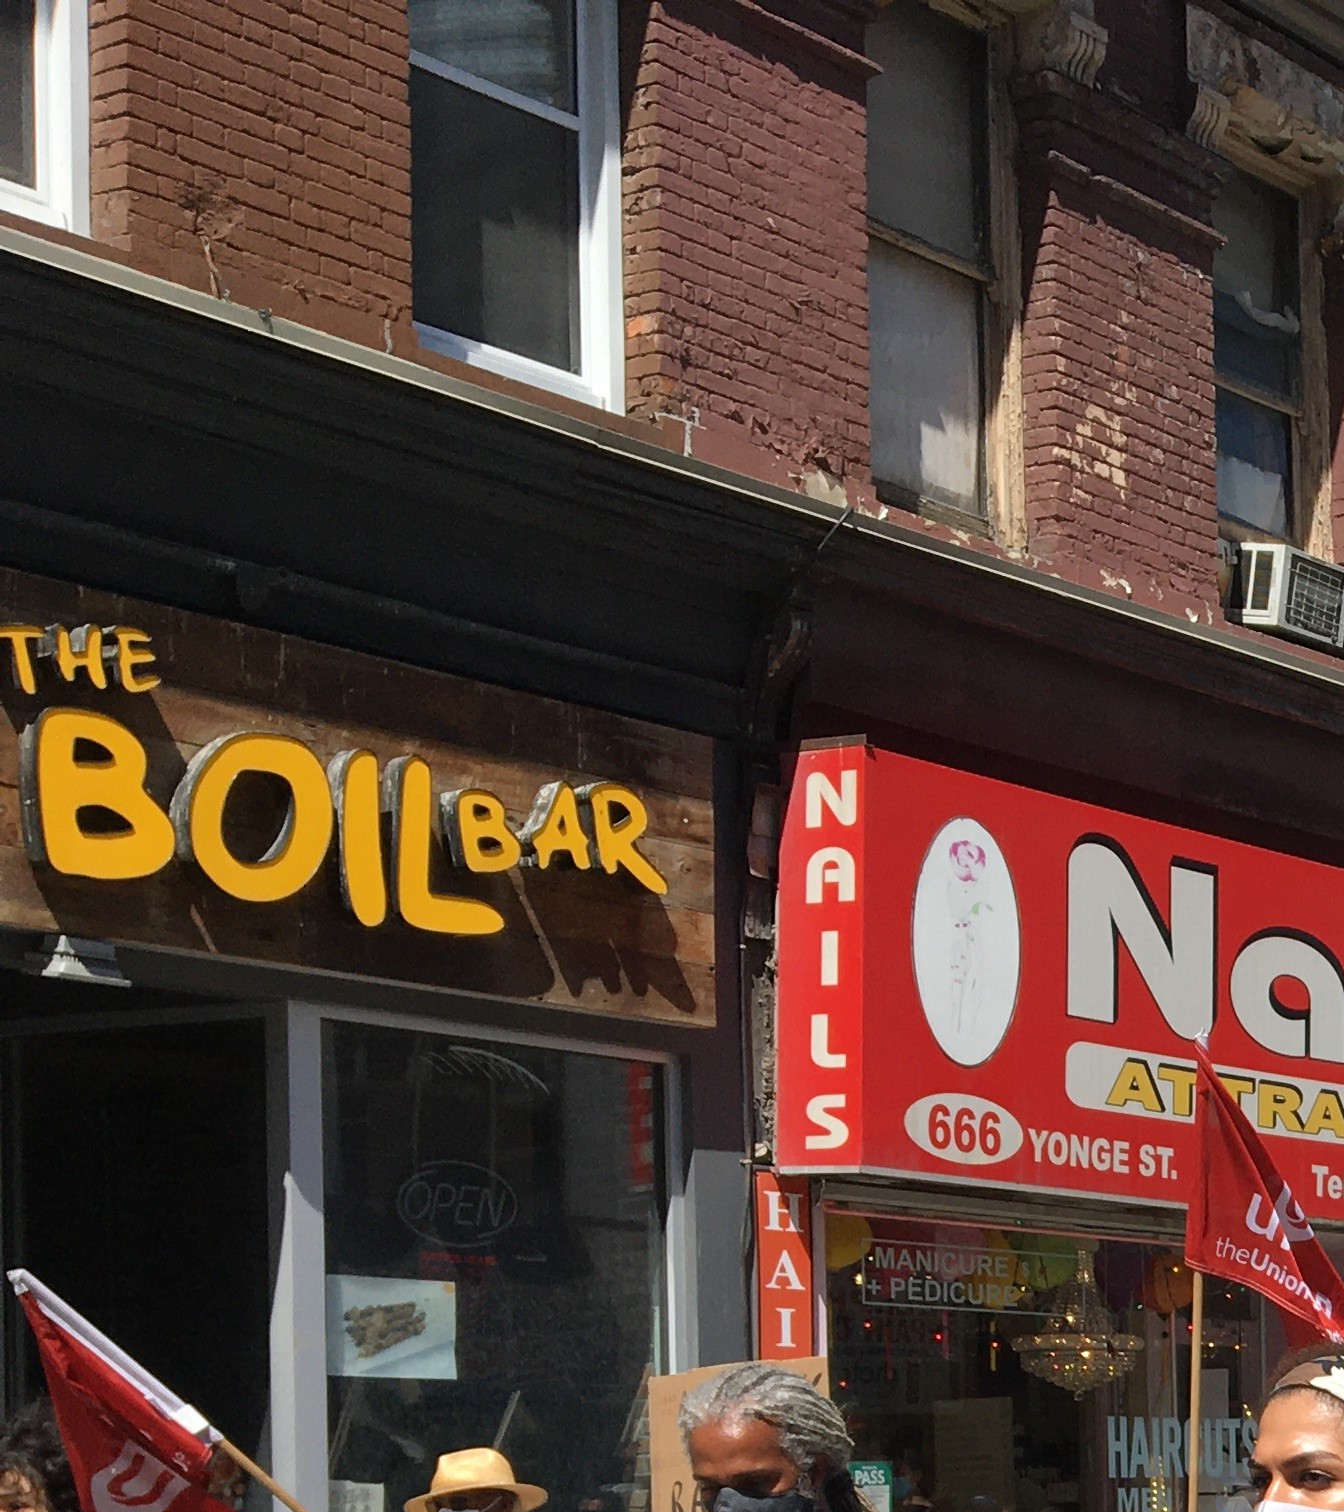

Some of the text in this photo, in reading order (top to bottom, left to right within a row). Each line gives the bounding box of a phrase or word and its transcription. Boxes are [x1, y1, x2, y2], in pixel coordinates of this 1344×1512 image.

[0, 625, 161, 694] THE
[37, 707, 667, 934] BOIL BAR
[804, 769, 857, 1150] NAILS
[927, 1110, 1178, 1180] 666 YONGE ST.
[404, 1181, 506, 1227] OPEN
[874, 1246, 1010, 1279] MANICURE
[890, 1278, 1020, 1308] PEDICURE
[855, 1470, 885, 1485] PASS
